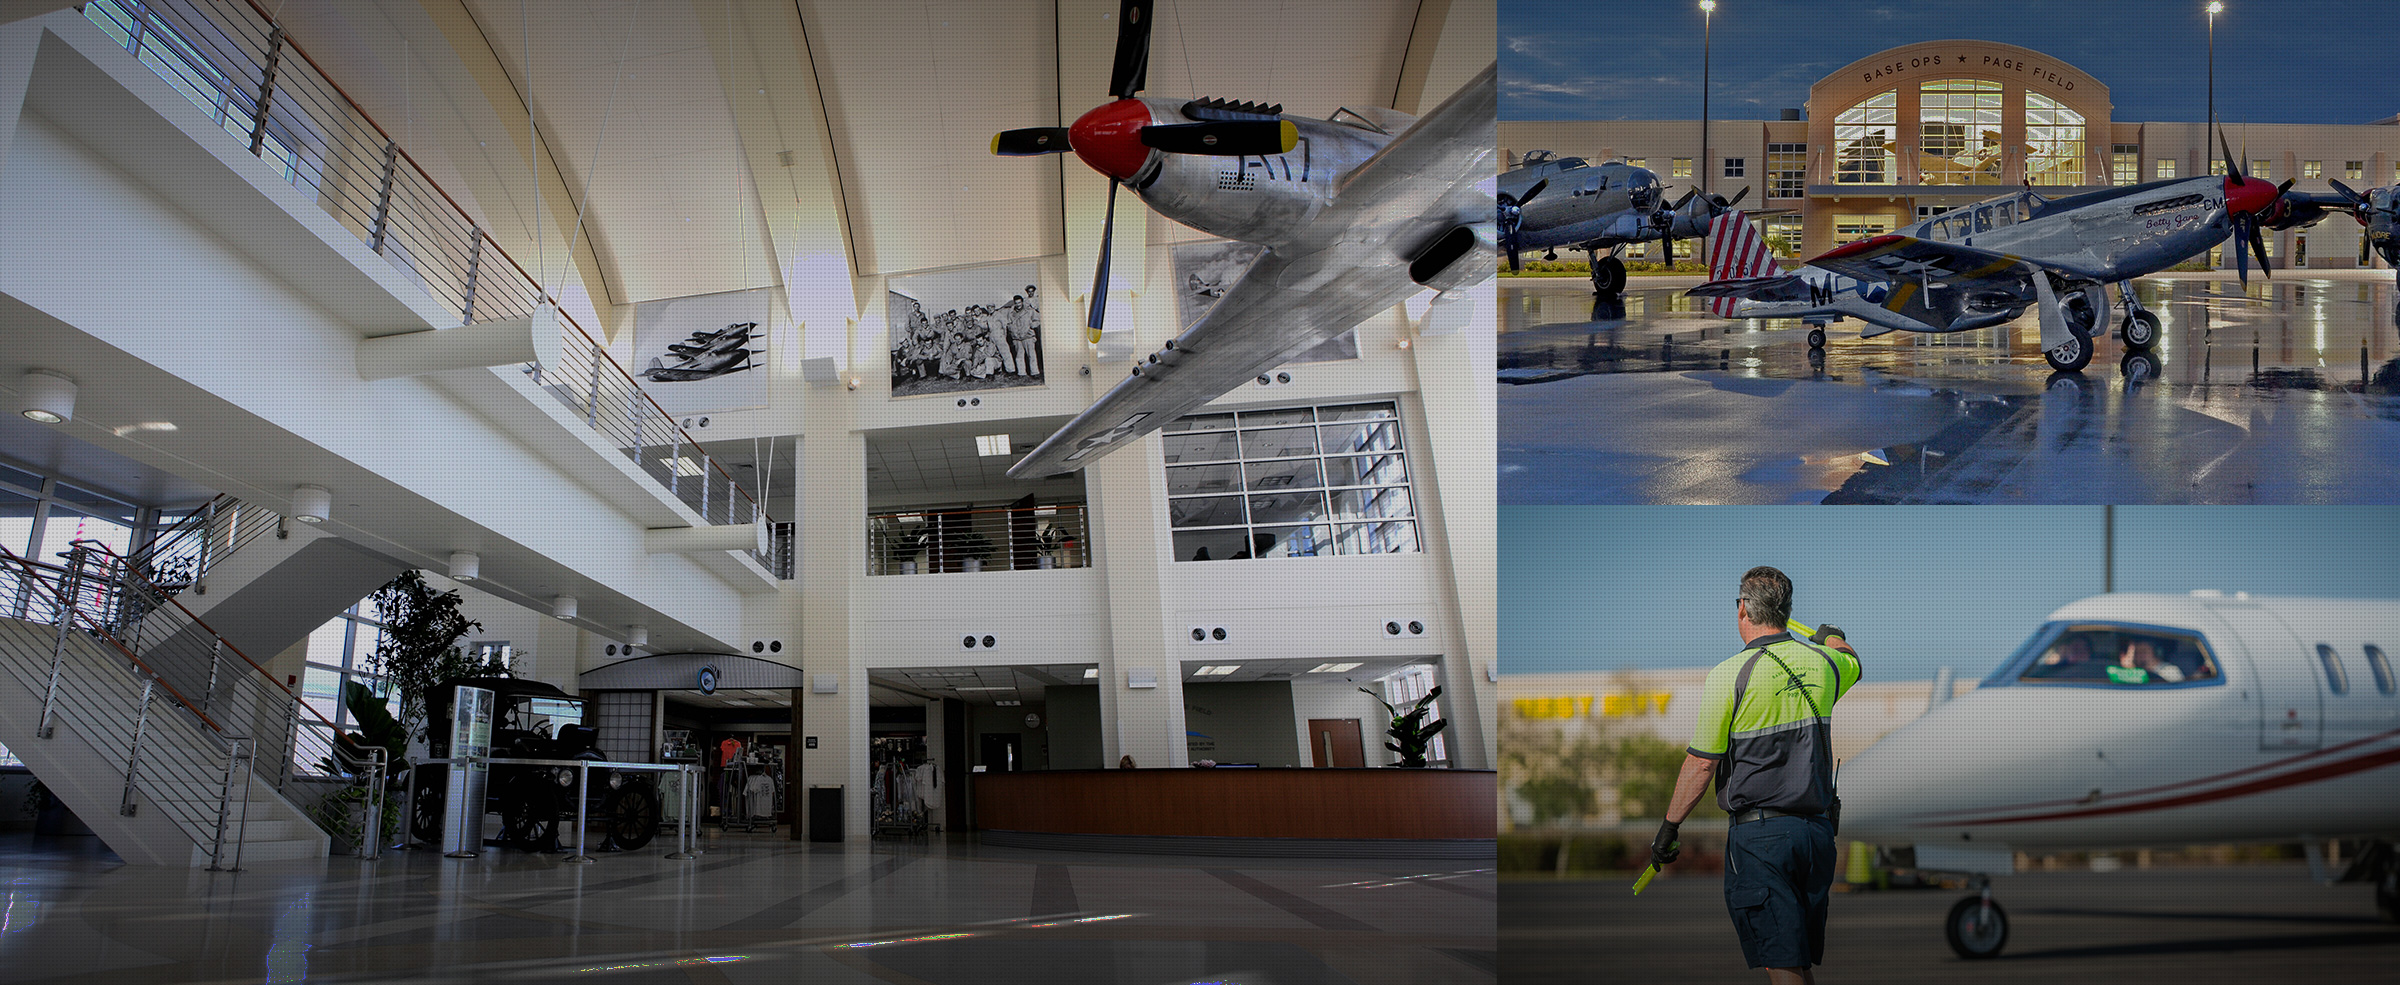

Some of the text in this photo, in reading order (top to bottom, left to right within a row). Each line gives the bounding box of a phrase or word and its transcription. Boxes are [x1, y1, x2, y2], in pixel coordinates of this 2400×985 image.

[1863, 55, 2075, 91] BASE OPS PAGE FIELD
[2283, 198, 2292, 218] 3
[2146, 214, 2200, 230] Betty Jane
